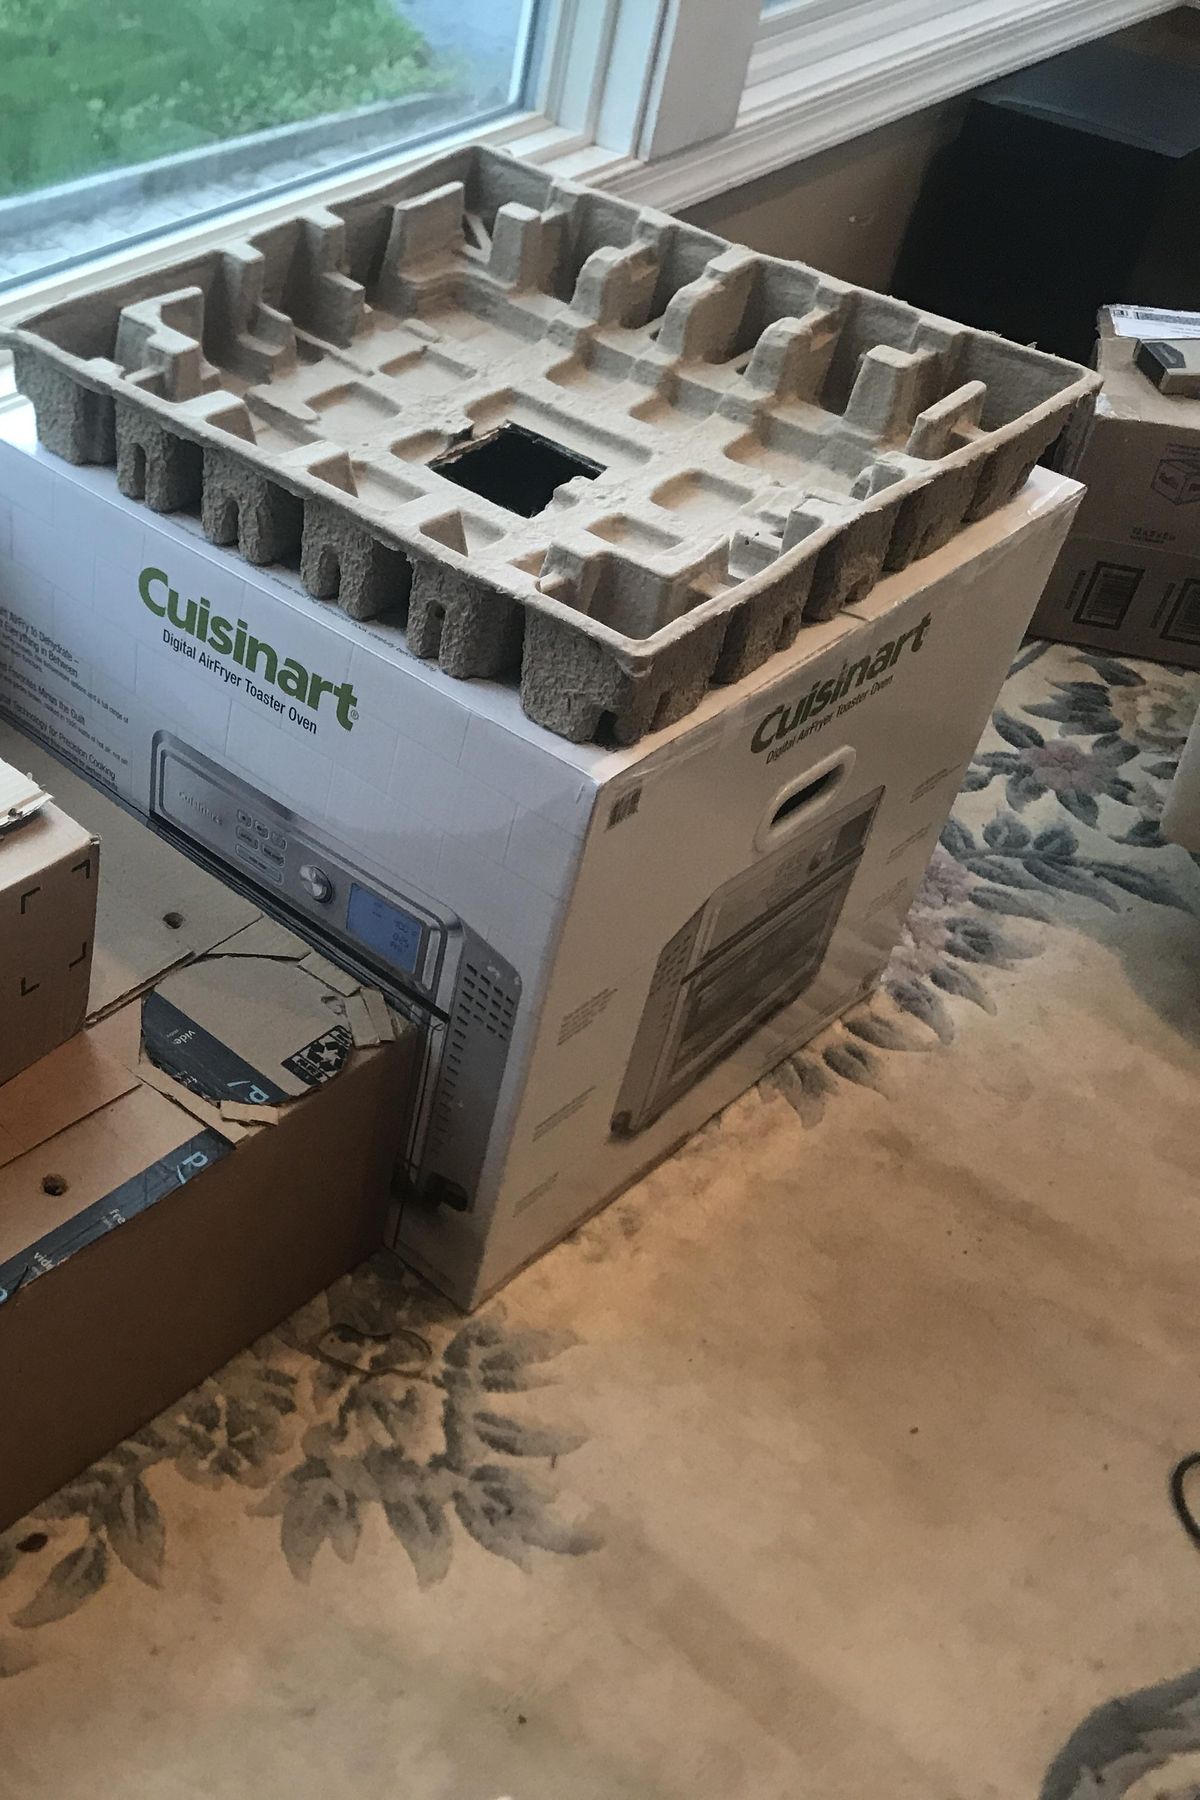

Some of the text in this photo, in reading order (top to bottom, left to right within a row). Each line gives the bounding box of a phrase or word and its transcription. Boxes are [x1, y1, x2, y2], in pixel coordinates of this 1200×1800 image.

[3, 620, 40, 653] Everything
[48, 649, 79, 678] Between
[38, 630, 73, 662] Dehydrate
[138, 567, 358, 732] Cuisinart
[162, 628, 318, 735] Digital AirFryer Toaster Oven
[750, 612, 932, 754] Cuisinart
[765, 674, 895, 765] Digital AirFryer Toaster Oven
[88, 753, 116, 782] Cooking
